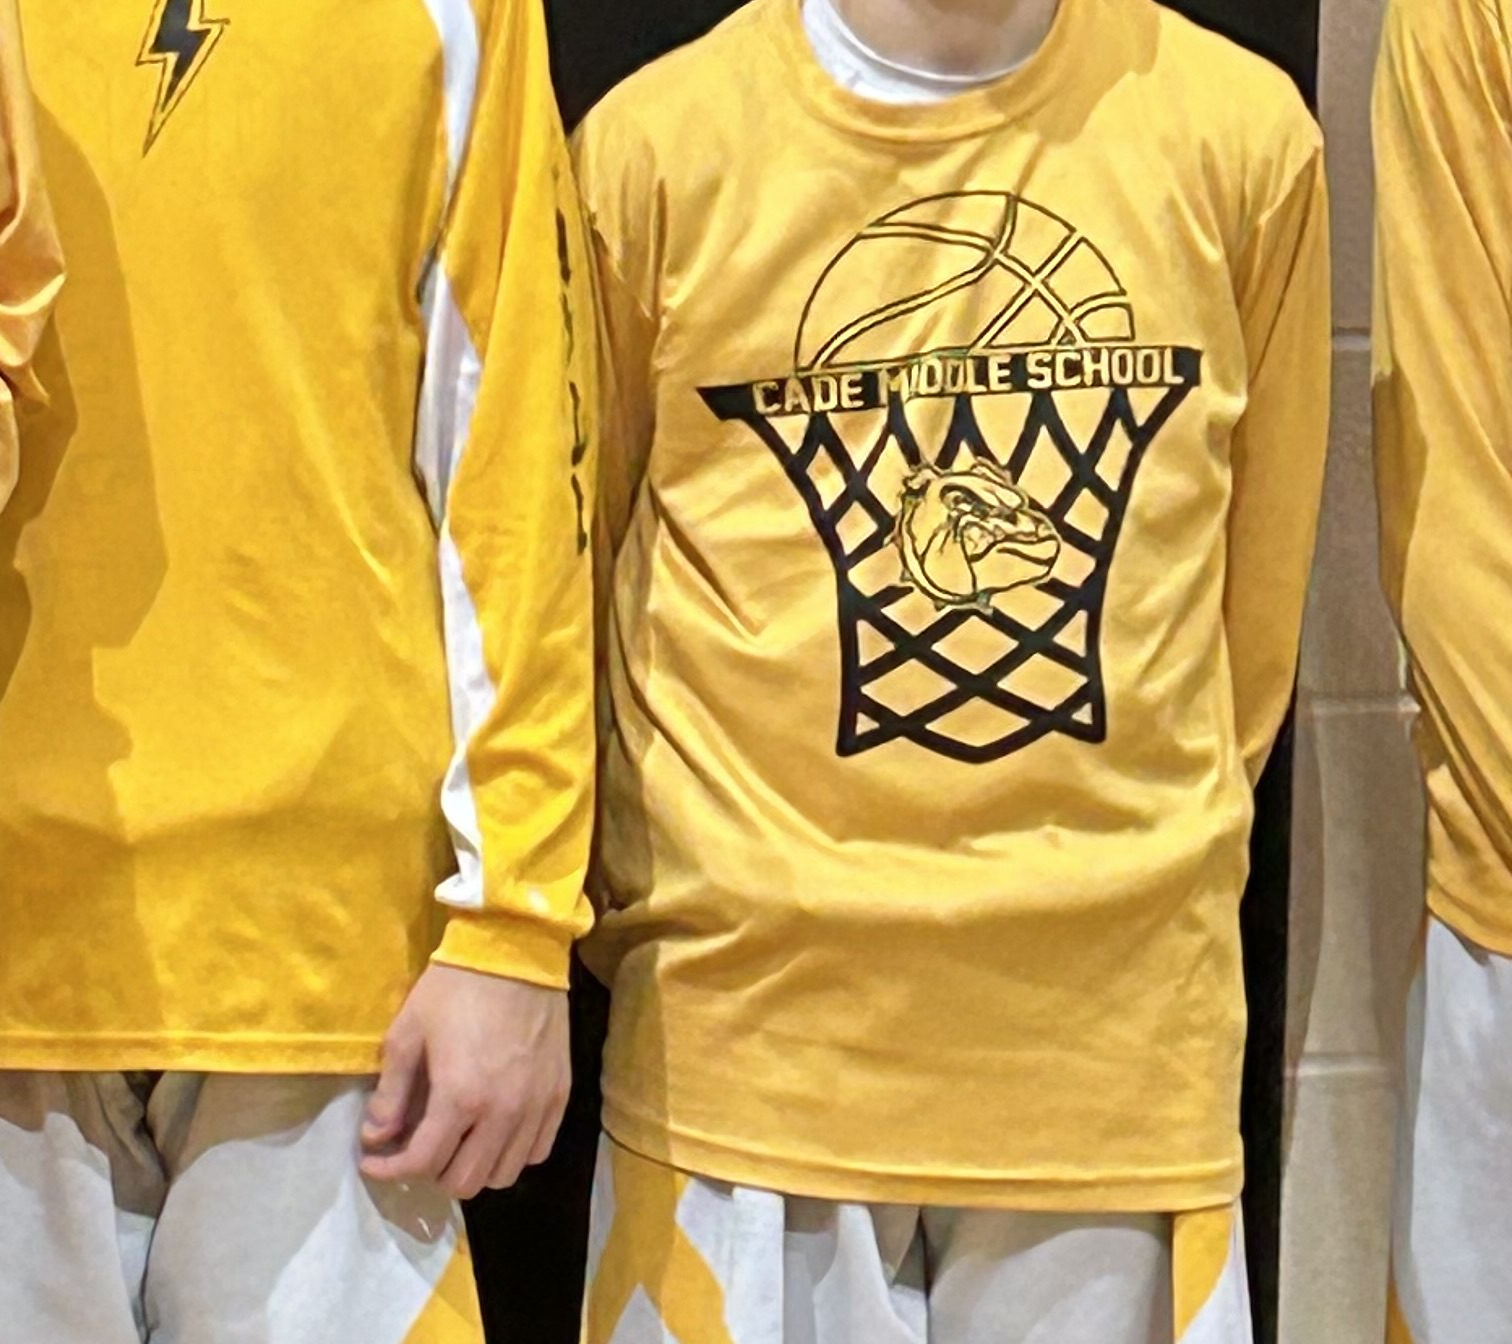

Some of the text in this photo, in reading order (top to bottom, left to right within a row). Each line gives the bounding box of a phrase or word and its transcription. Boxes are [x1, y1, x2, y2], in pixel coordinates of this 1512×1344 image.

[751, 346, 1185, 415] CADE MIDDLE SCHOOL
